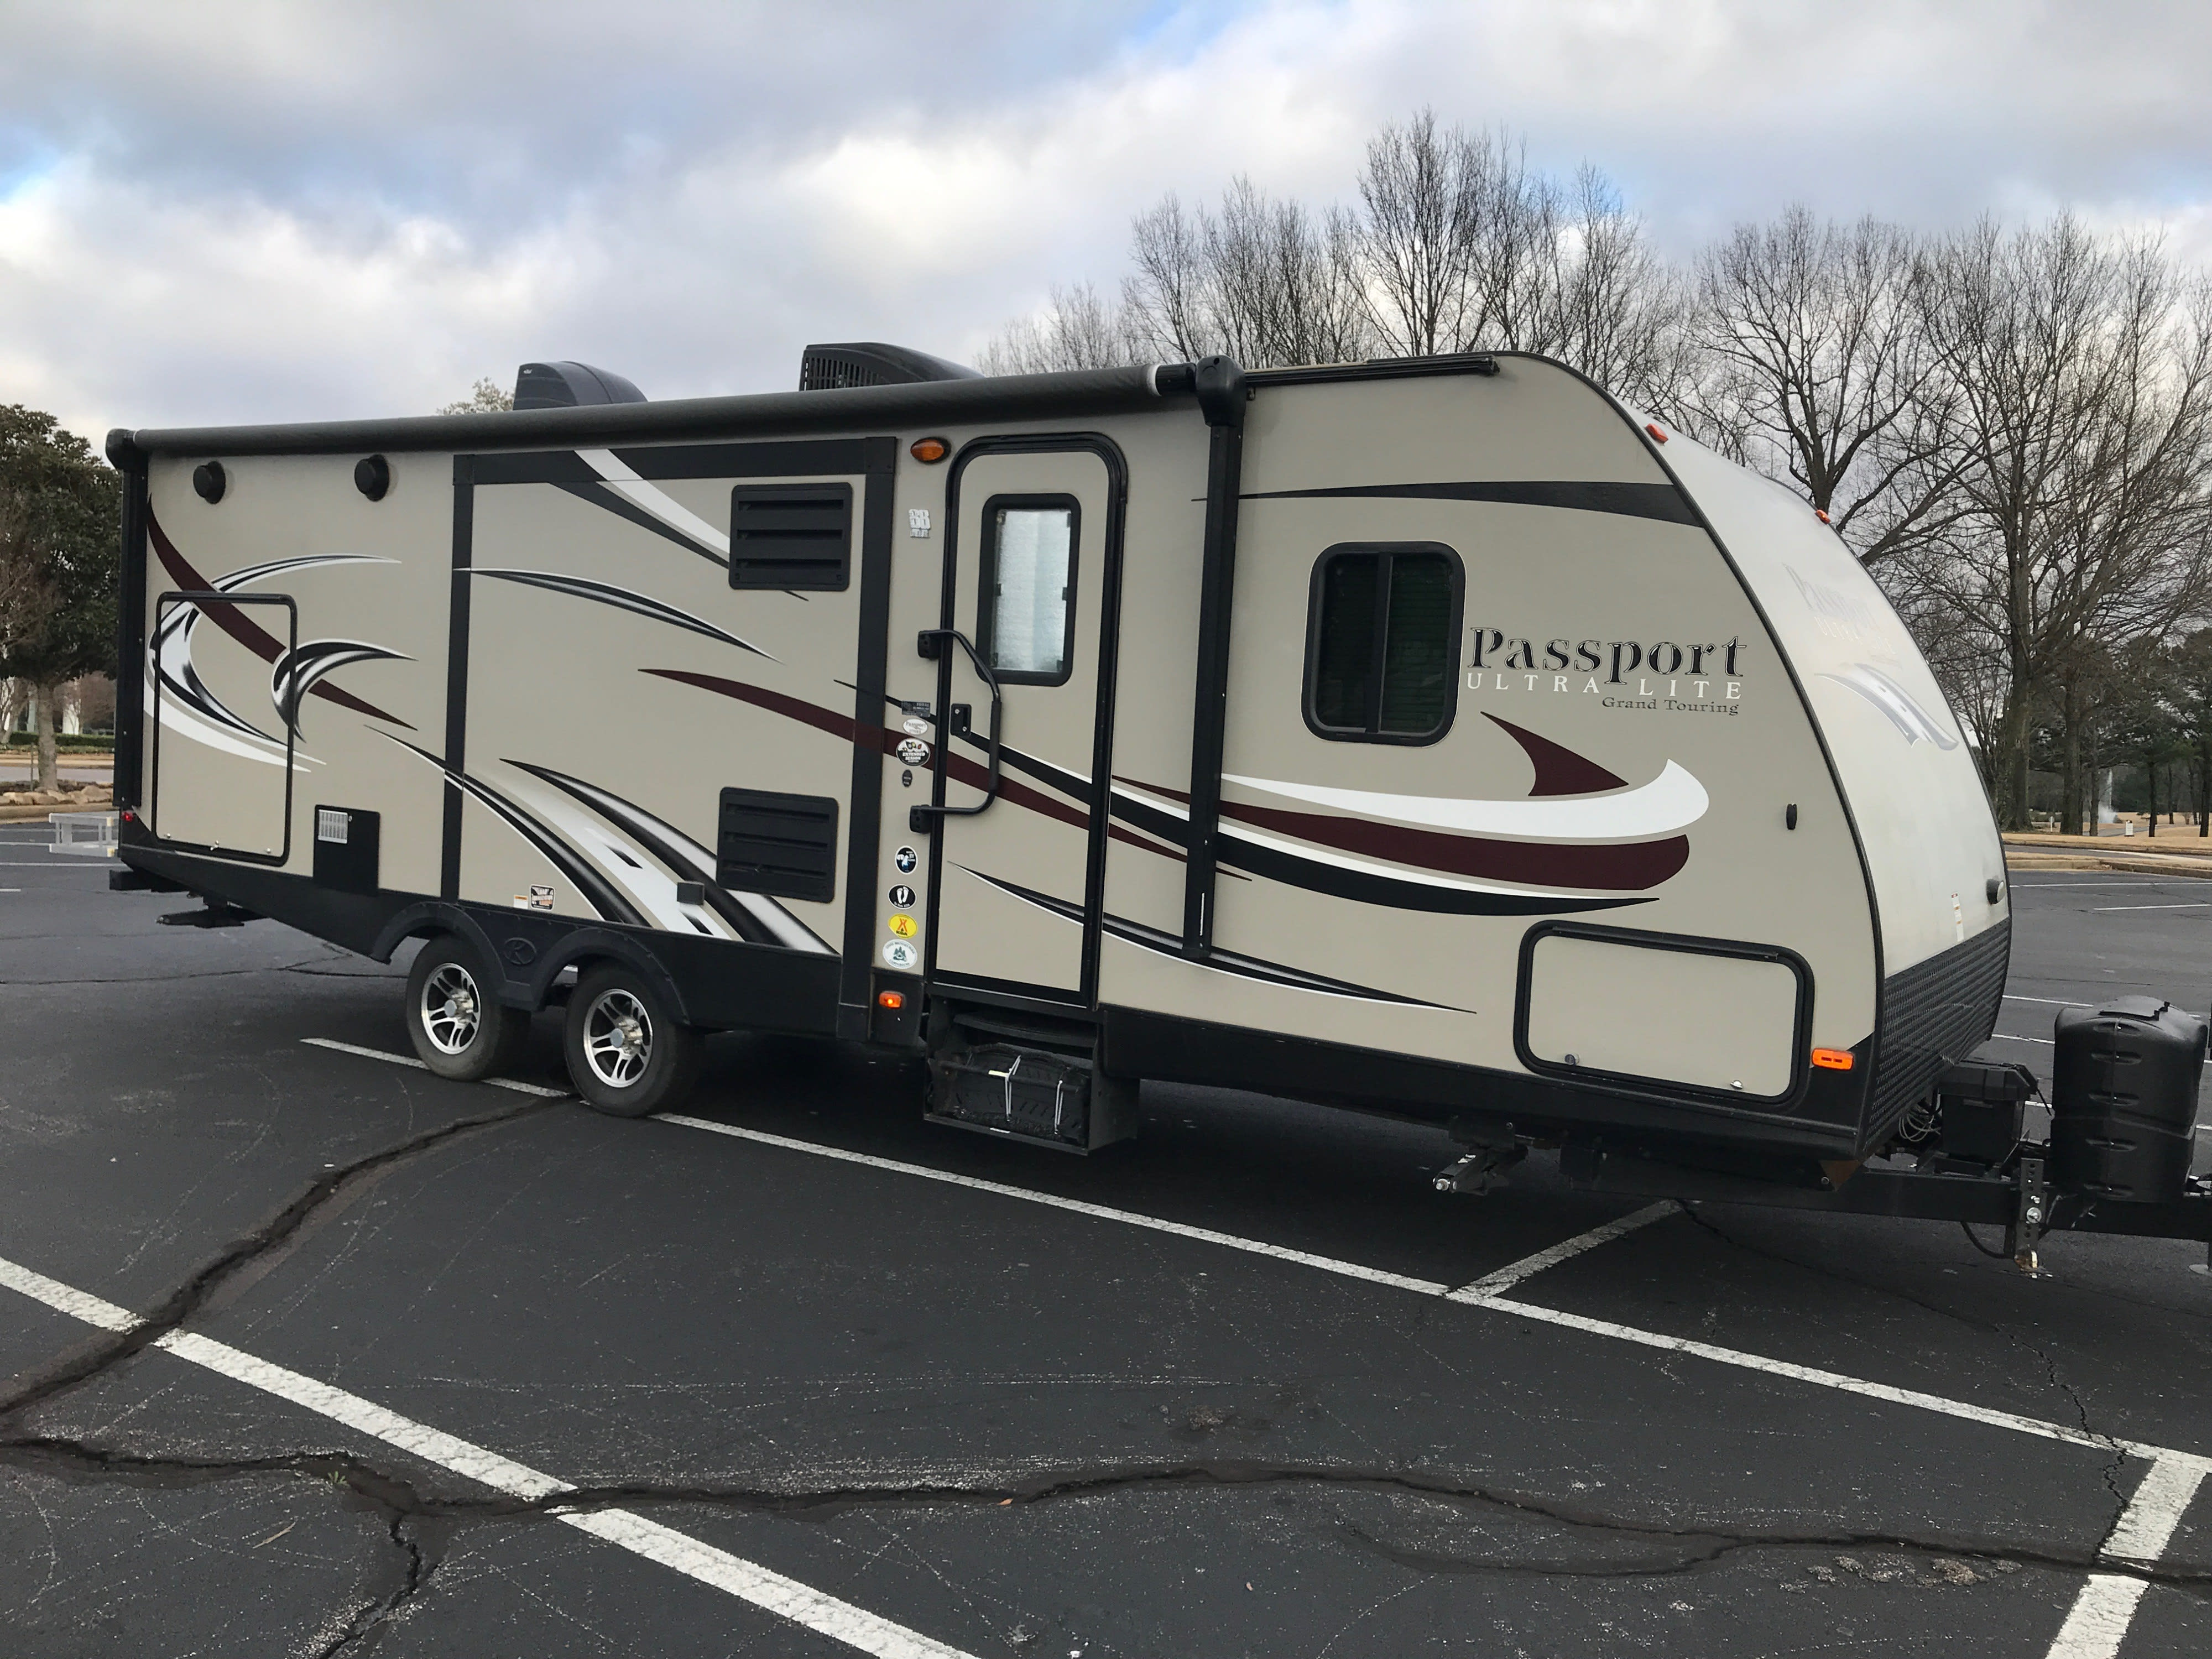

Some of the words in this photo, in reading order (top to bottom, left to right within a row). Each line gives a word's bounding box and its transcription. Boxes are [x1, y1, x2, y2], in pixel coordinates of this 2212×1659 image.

[1467, 627, 1747, 685] Passport
[1467, 672, 1600, 693] ULTRA
[1639, 678, 1741, 699] LITE
[1601, 697, 1657, 710] Grand
[1665, 699, 1739, 716] Touring
